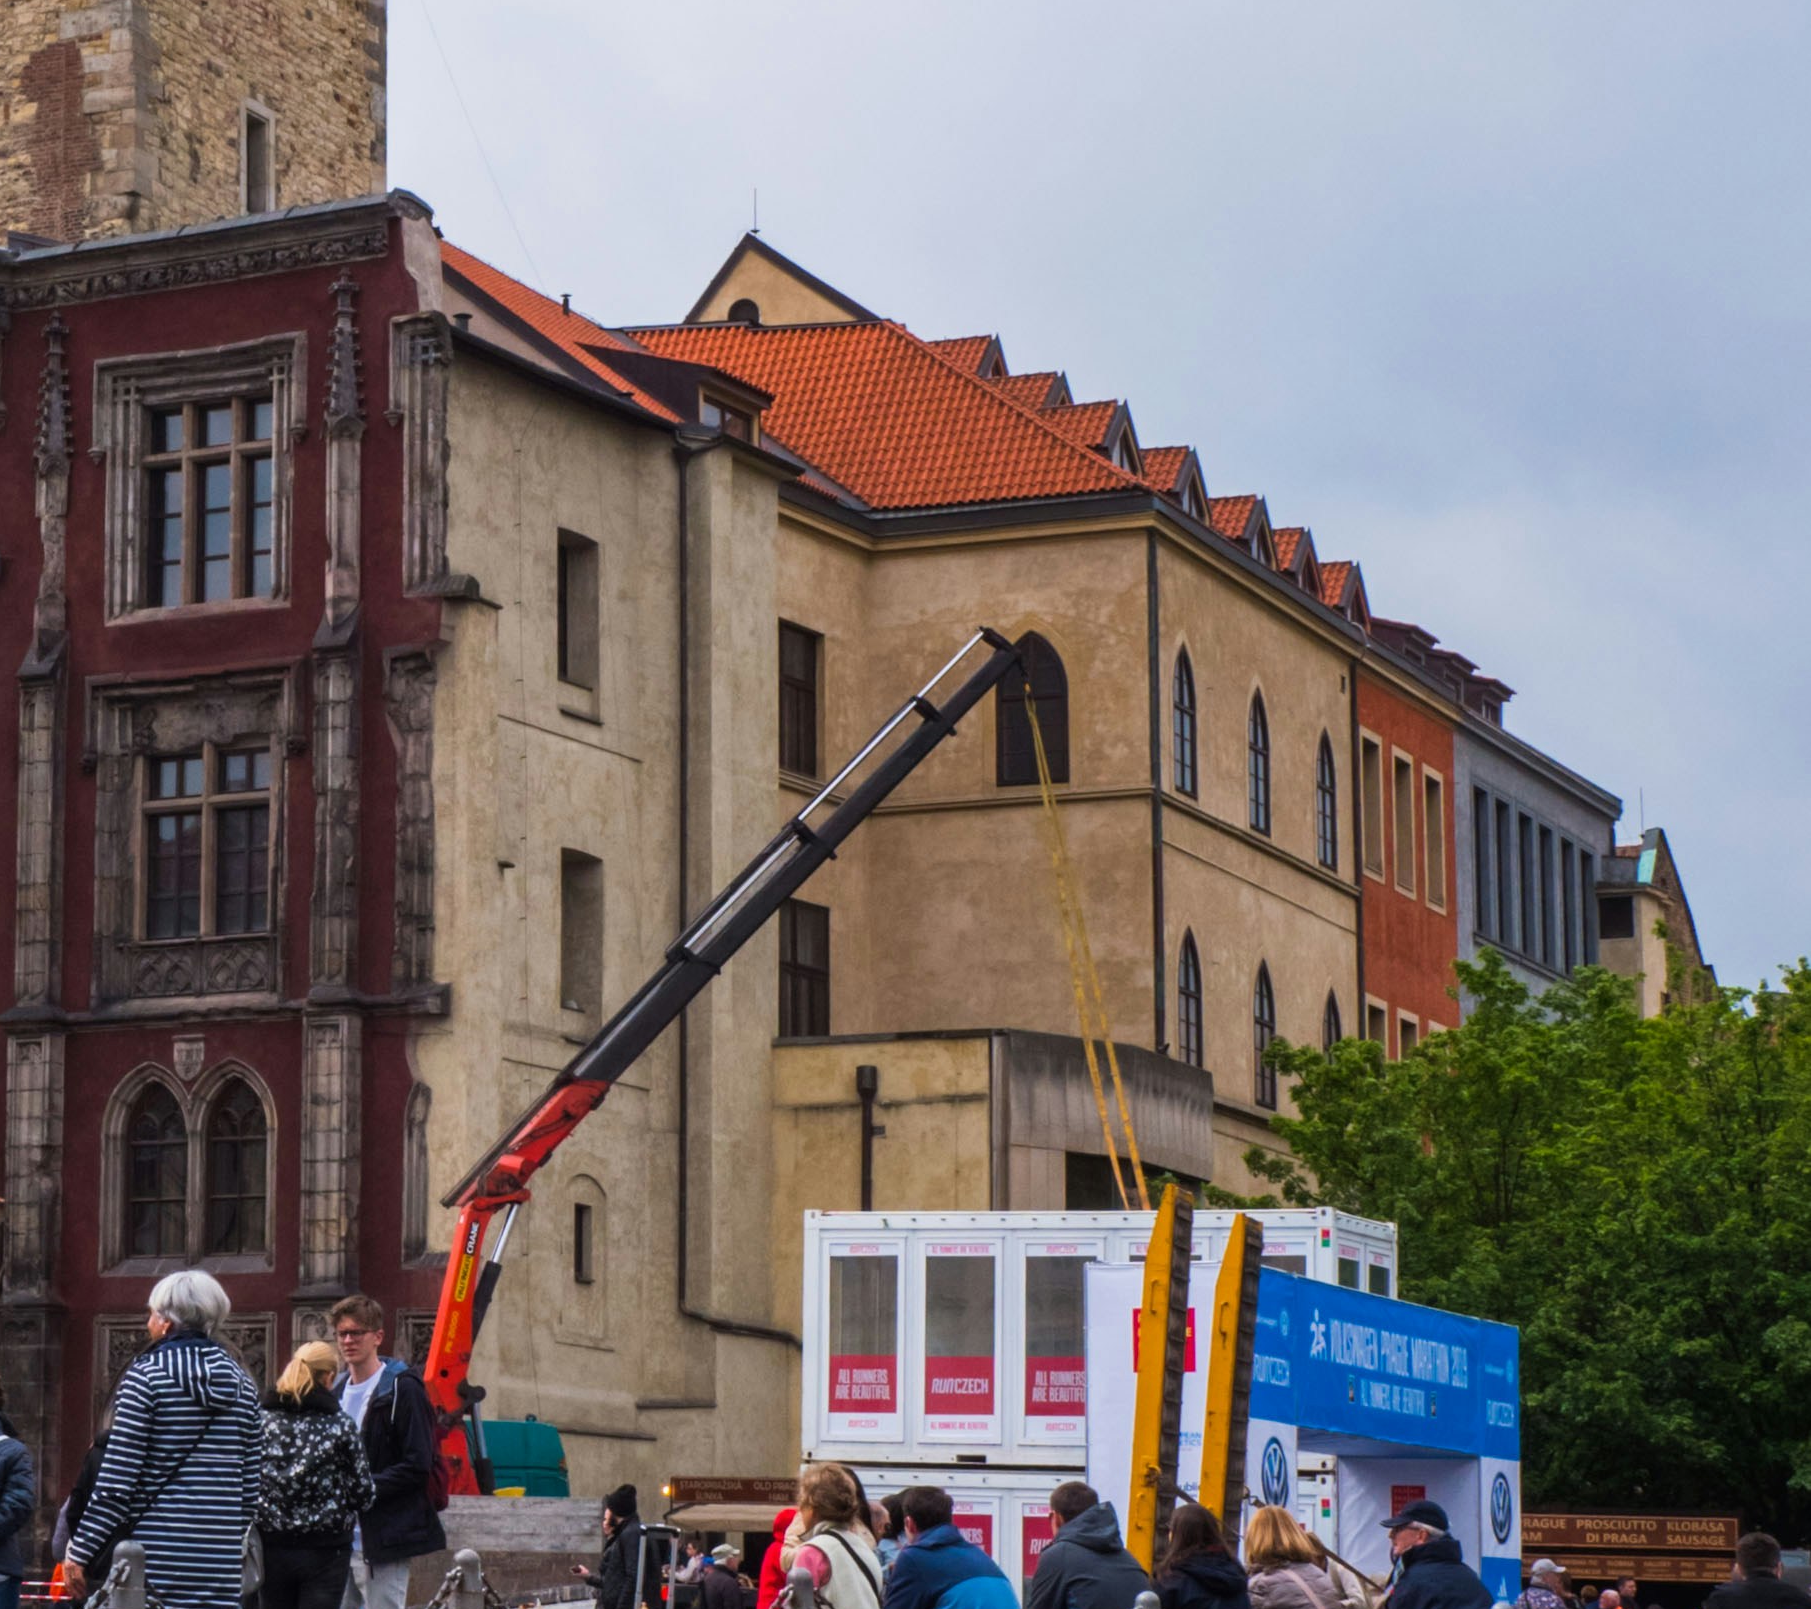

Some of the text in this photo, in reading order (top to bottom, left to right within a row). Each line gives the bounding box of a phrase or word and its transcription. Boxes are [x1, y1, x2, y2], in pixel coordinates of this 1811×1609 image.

[467, 1222, 479, 1254] CRANE
[1330, 1319, 1379, 1371] VOLKSWAGEN
[1380, 1330, 1410, 1378] PRAGUE
[1410, 1336, 1450, 1385] MARATHON
[838, 1369, 888, 1384] ALL RUNNERS
[1035, 1371, 1048, 1386] ALL
[835, 1384, 890, 1400] ARE BEAUTIFUL
[931, 1378, 989, 1394] RUNCZECH
[1032, 1386, 1086, 1402] ARE BEAUTIFU
[752, 1481, 772, 1490] OLD
[1522, 1518, 1566, 1529] RAGUE
[1576, 1519, 1657, 1531] PROSCIUTTO
[1522, 1532, 1542, 1542] AM
[1586, 1533, 1647, 1544] DI PRAGA
[1666, 1535, 1725, 1546] SAUSAGE
